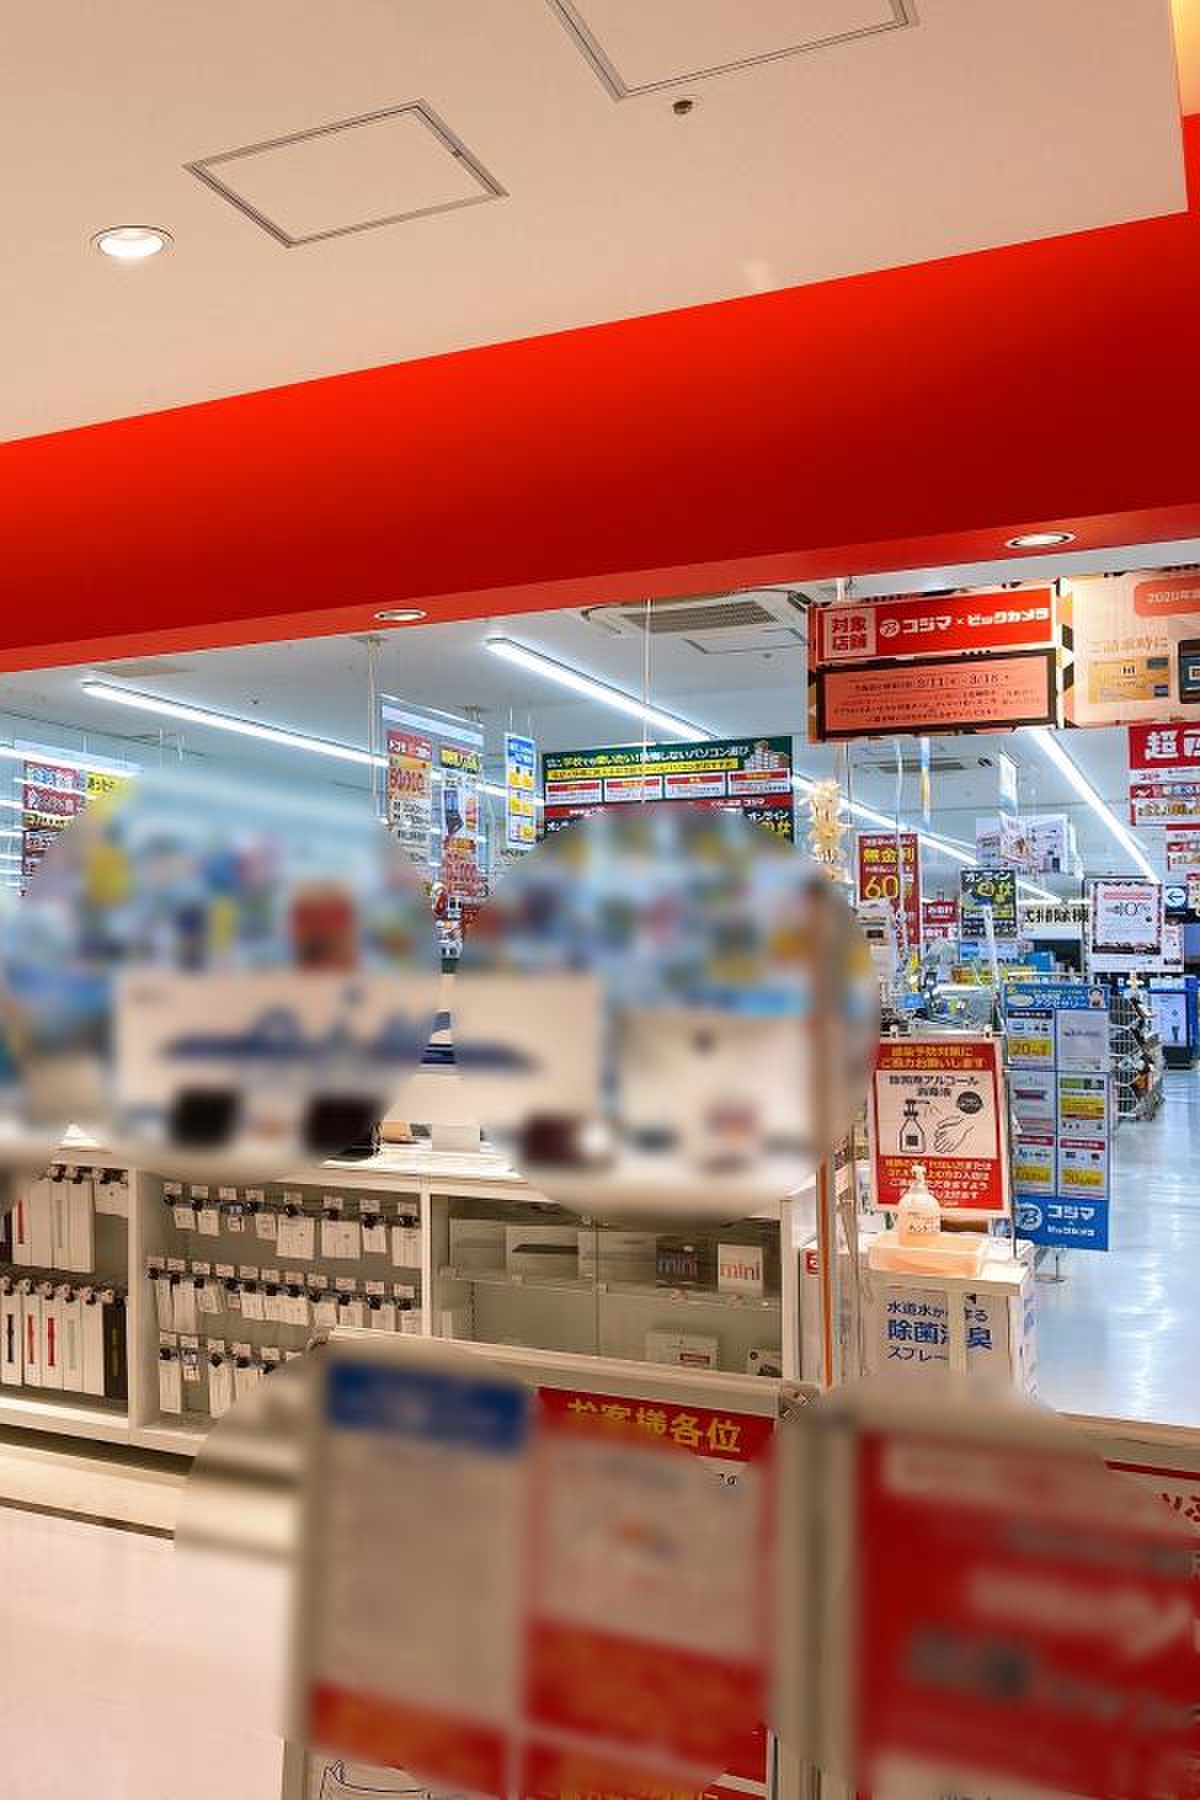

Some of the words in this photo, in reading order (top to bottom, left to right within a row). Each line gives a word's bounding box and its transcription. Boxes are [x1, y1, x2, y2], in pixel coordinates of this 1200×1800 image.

[1047, 1205, 1095, 1220] コジマ
[719, 1260, 762, 1282] mini
